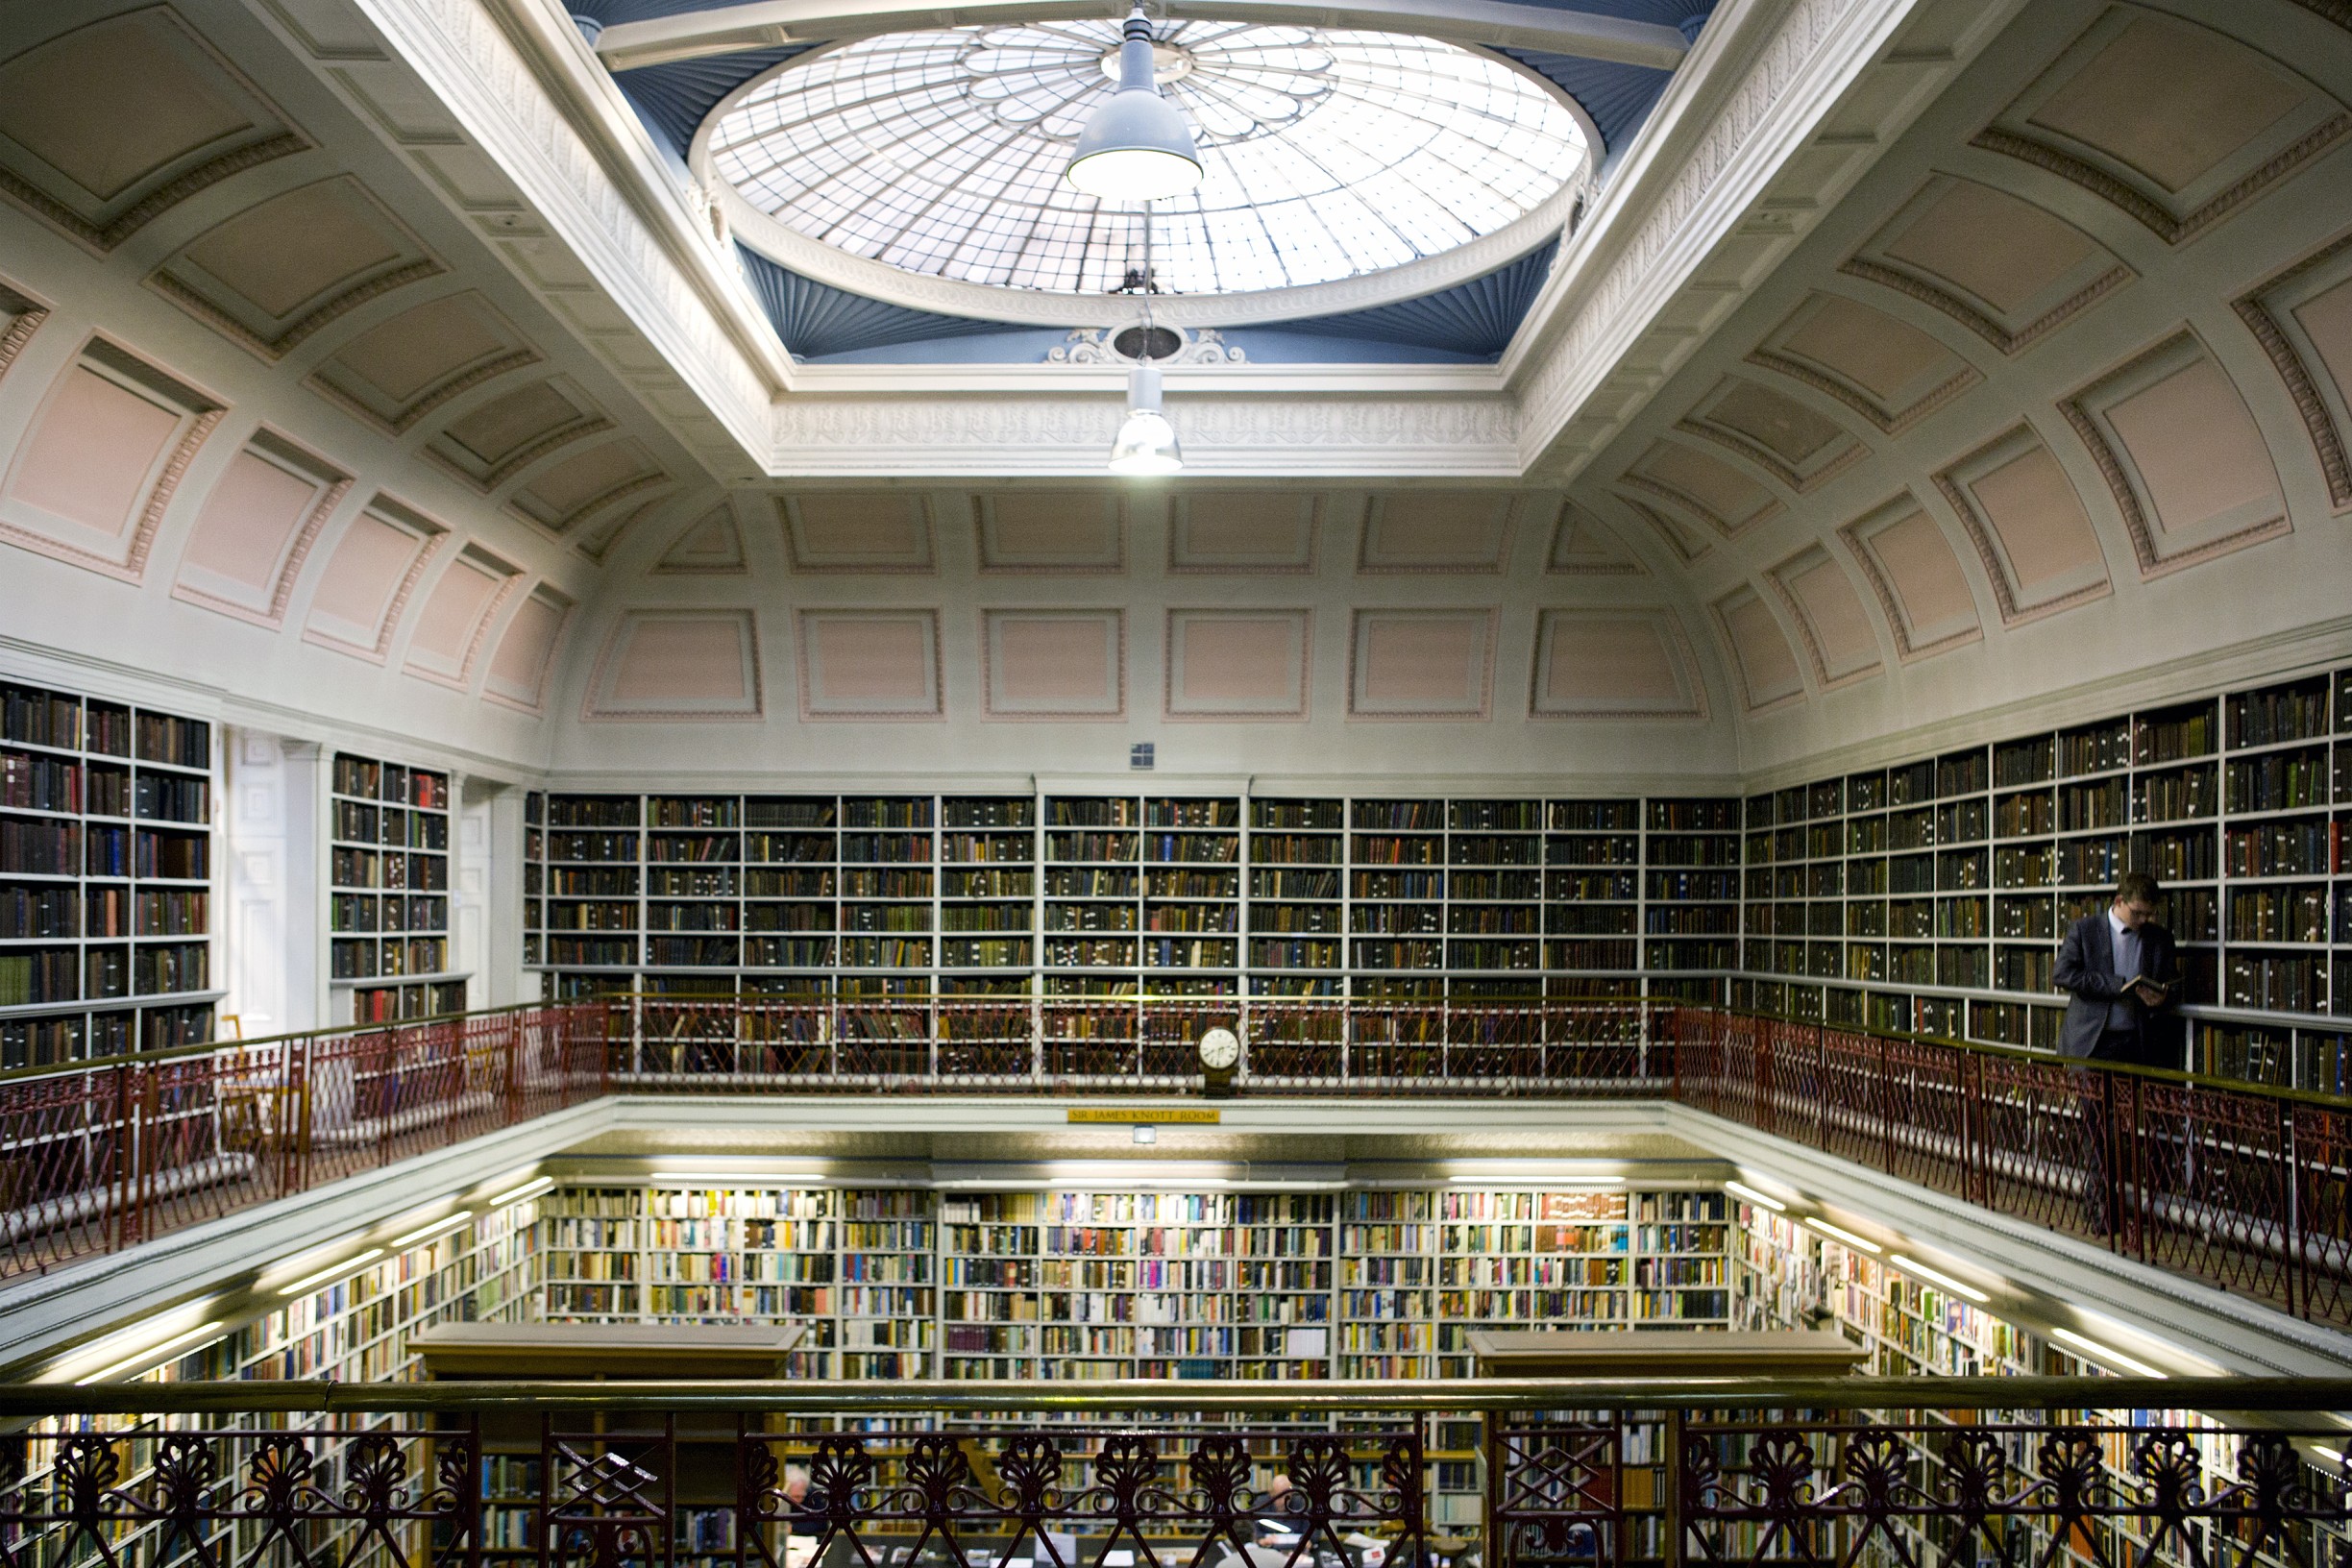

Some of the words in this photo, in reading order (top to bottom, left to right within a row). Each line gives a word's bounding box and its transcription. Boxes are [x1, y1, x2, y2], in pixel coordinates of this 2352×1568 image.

[1072, 1110, 1089, 1120] SIR
[1094, 1110, 1127, 1120] JAMES
[1132, 1110, 1173, 1120] KNOTT
[1180, 1110, 1215, 1120] ROOM
